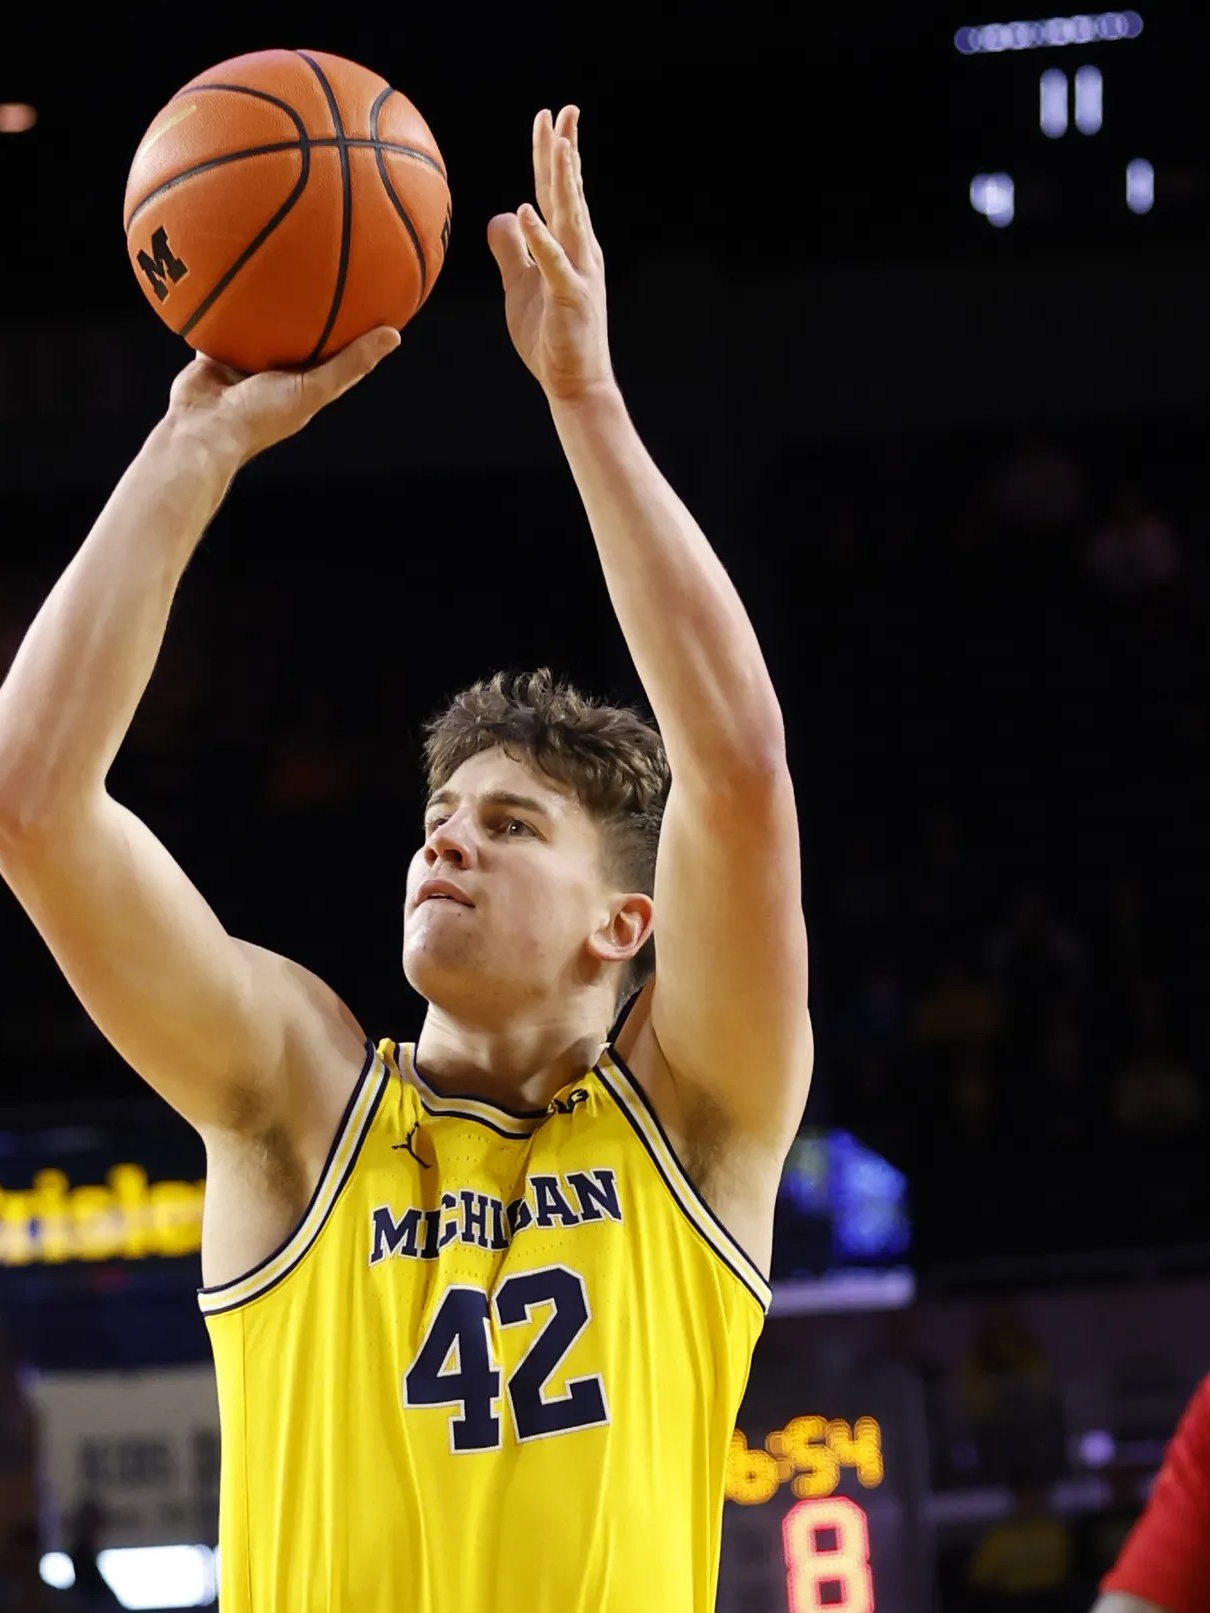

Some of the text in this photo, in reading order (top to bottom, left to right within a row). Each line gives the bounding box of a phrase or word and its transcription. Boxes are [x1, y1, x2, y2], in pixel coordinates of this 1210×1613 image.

[136, 225, 189, 304] M
[368, 1168, 624, 1267] MICHIGAN
[402, 1263, 610, 1455] 42
[781, 1496, 875, 1613] 8
